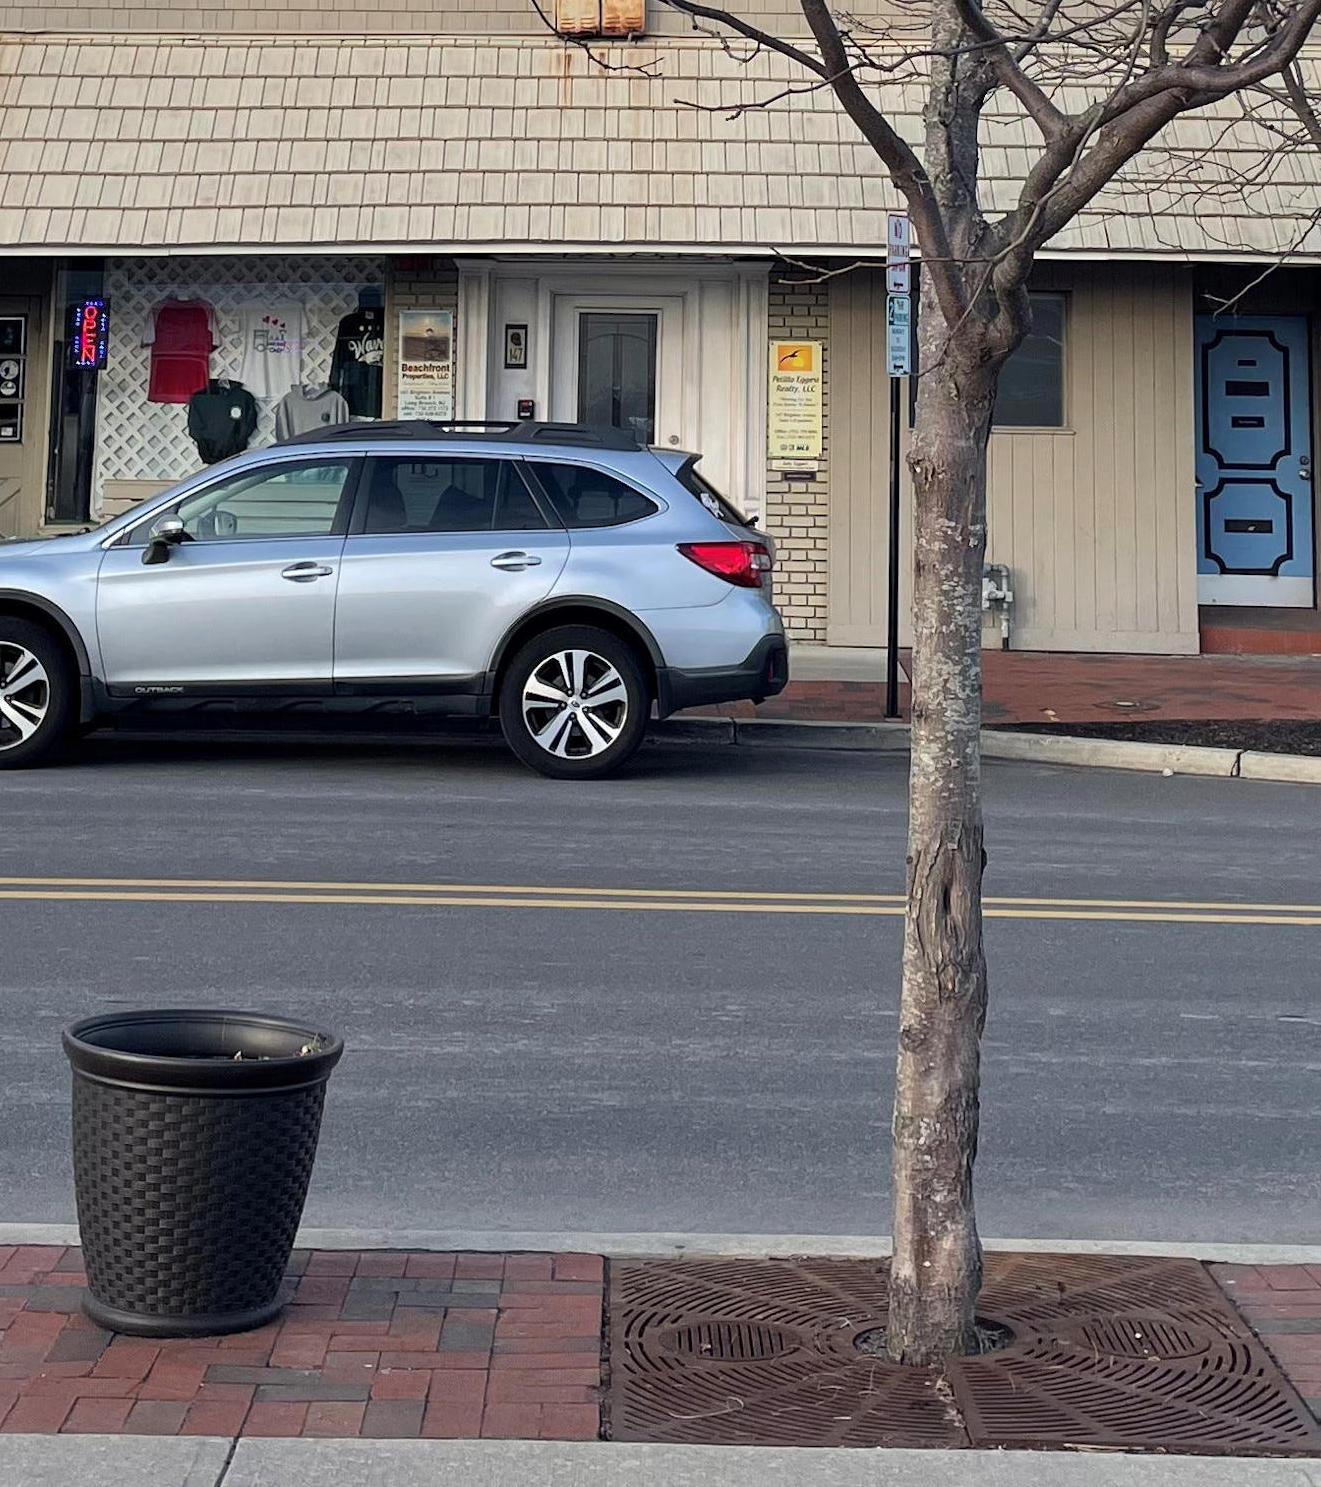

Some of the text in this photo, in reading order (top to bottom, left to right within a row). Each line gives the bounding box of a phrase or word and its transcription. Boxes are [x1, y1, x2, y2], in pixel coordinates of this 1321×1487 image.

[81, 306, 97, 362] OPEN
[509, 348, 523, 362] 147
[402, 364, 449, 372] Beachfront
